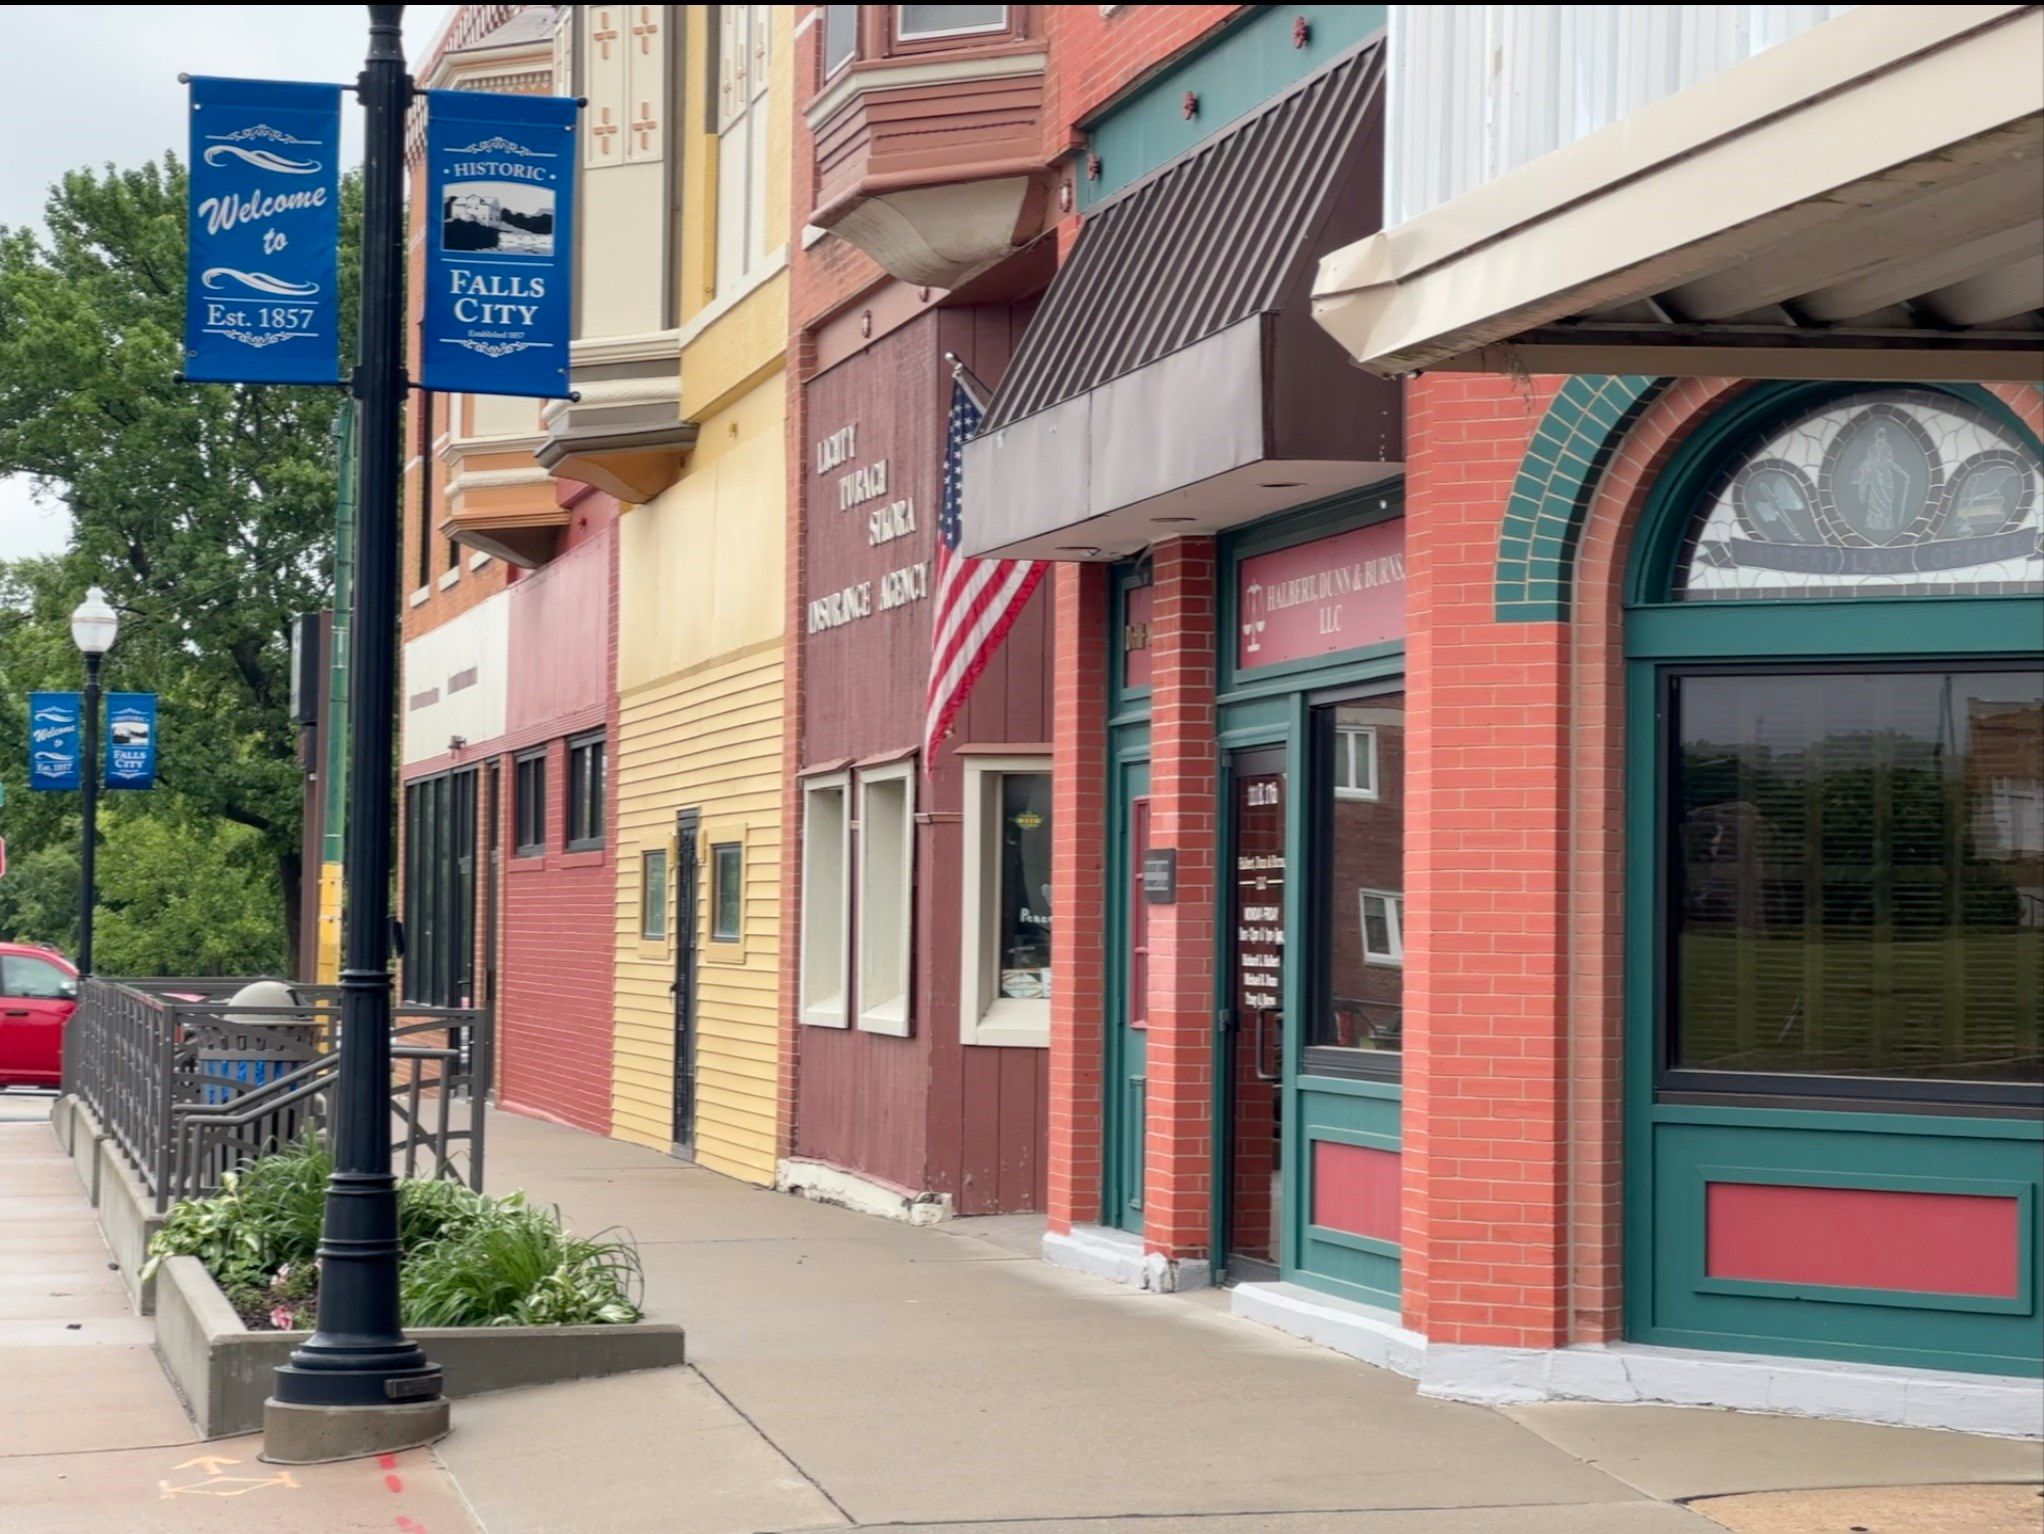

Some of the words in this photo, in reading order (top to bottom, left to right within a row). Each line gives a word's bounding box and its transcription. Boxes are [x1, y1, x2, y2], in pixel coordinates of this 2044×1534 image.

[453, 161, 547, 181] HISTORIC
[198, 187, 327, 235] Welcome
[263, 228, 288, 254] to
[449, 269, 545, 298] FALLS
[207, 304, 252, 326] Est.
[259, 308, 314, 329] 1857
[454, 297, 539, 325] CITY
[1353, 563, 1363, 592] &
[808, 581, 871, 635] INSURANCE
[879, 560, 929, 611] AGENCY
[1319, 604, 1343, 635] LLC
[115, 759, 145, 769] CITY
